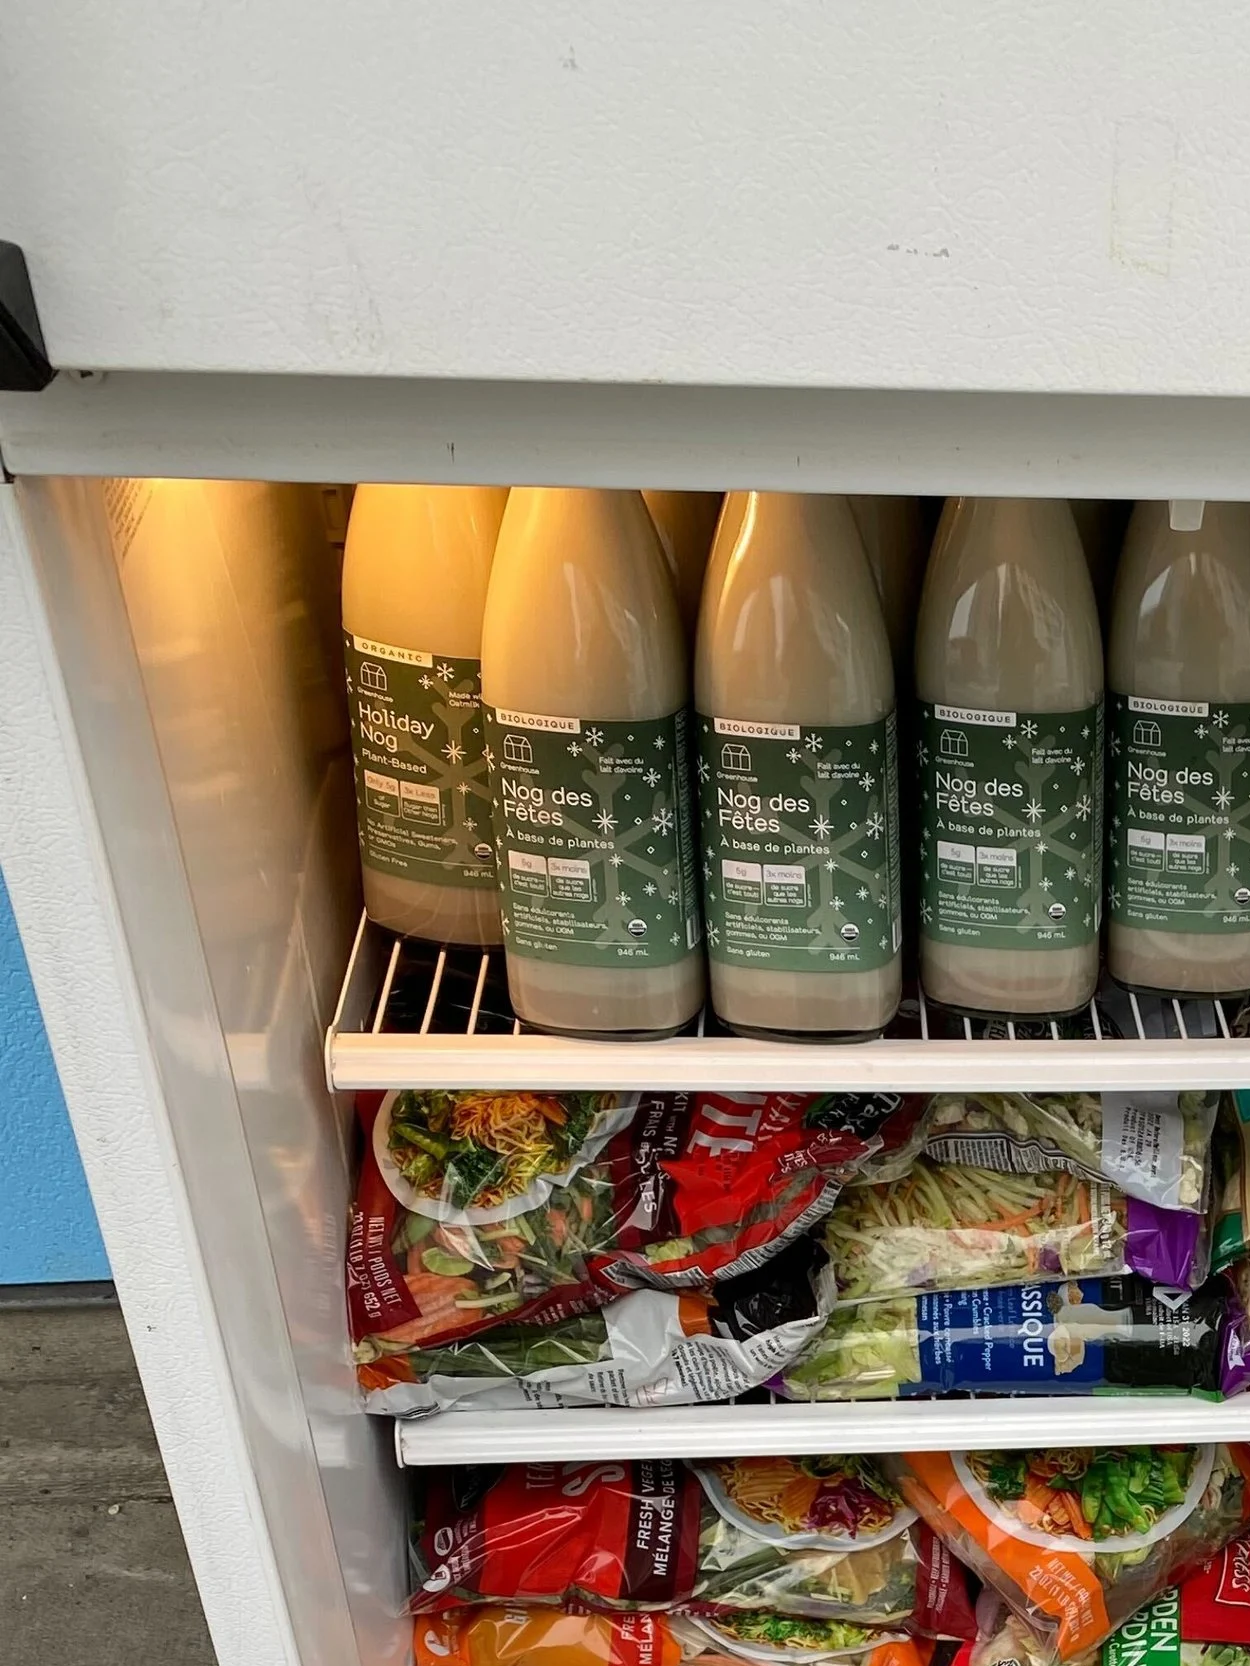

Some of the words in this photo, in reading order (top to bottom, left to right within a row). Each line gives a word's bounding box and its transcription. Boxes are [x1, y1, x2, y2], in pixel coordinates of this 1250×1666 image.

[362, 642, 422, 663] ORGANIC
[939, 709, 1011, 724] BIOLOGIQUE
[1133, 700, 1204, 714] BIOLOGIQUE
[358, 701, 434, 740] Holiday
[500, 713, 575, 730] BIOLOGIQUE
[719, 722, 795, 737] BIOLOGIQUE
[360, 721, 397, 752] Nog
[361, 748, 427, 774] Plant-Based
[1127, 760, 1169, 787] Nog
[1175, 767, 1214, 786] des
[501, 777, 544, 807] Nog
[552, 786, 593, 807] des
[935, 771, 977, 799] Nog
[984, 778, 1024, 797] des
[1127, 781, 1185, 804] Fêtes
[503, 799, 564, 826] Fêtes
[717, 787, 761, 814] Nog
[769, 793, 810, 813] des
[936, 792, 994, 817] Fêtes
[719, 808, 781, 833] Fêtes
[1127, 804, 1137, 818] À
[1139, 809, 1165, 822] base
[1168, 813, 1183, 823] de
[1186, 814, 1230, 826] plantes
[506, 824, 515, 839] À
[517, 830, 545, 844] base
[549, 835, 564, 846] de
[567, 837, 615, 850] plantes
[936, 817, 945, 829] À
[948, 821, 975, 834] base
[978, 825, 993, 836] de
[996, 826, 1041, 839] plantes
[720, 834, 730, 848] À
[732, 839, 760, 851] base
[765, 842, 780, 852] de
[784, 843, 830, 855] plantes
[643, 1100, 664, 1136] FRAIS
[368, 1217, 385, 1232] NET
[368, 1256, 392, 1287] POIDS
[364, 1292, 381, 1311] 652
[381, 1287, 402, 1304] NET
[981, 1342, 993, 1371] Pepper
[637, 1499, 653, 1550] FRESH
[654, 1499, 675, 1576] MÉLANGE
[621, 1615, 635, 1640] FRE
[640, 1614, 653, 1664] MÉLAN
